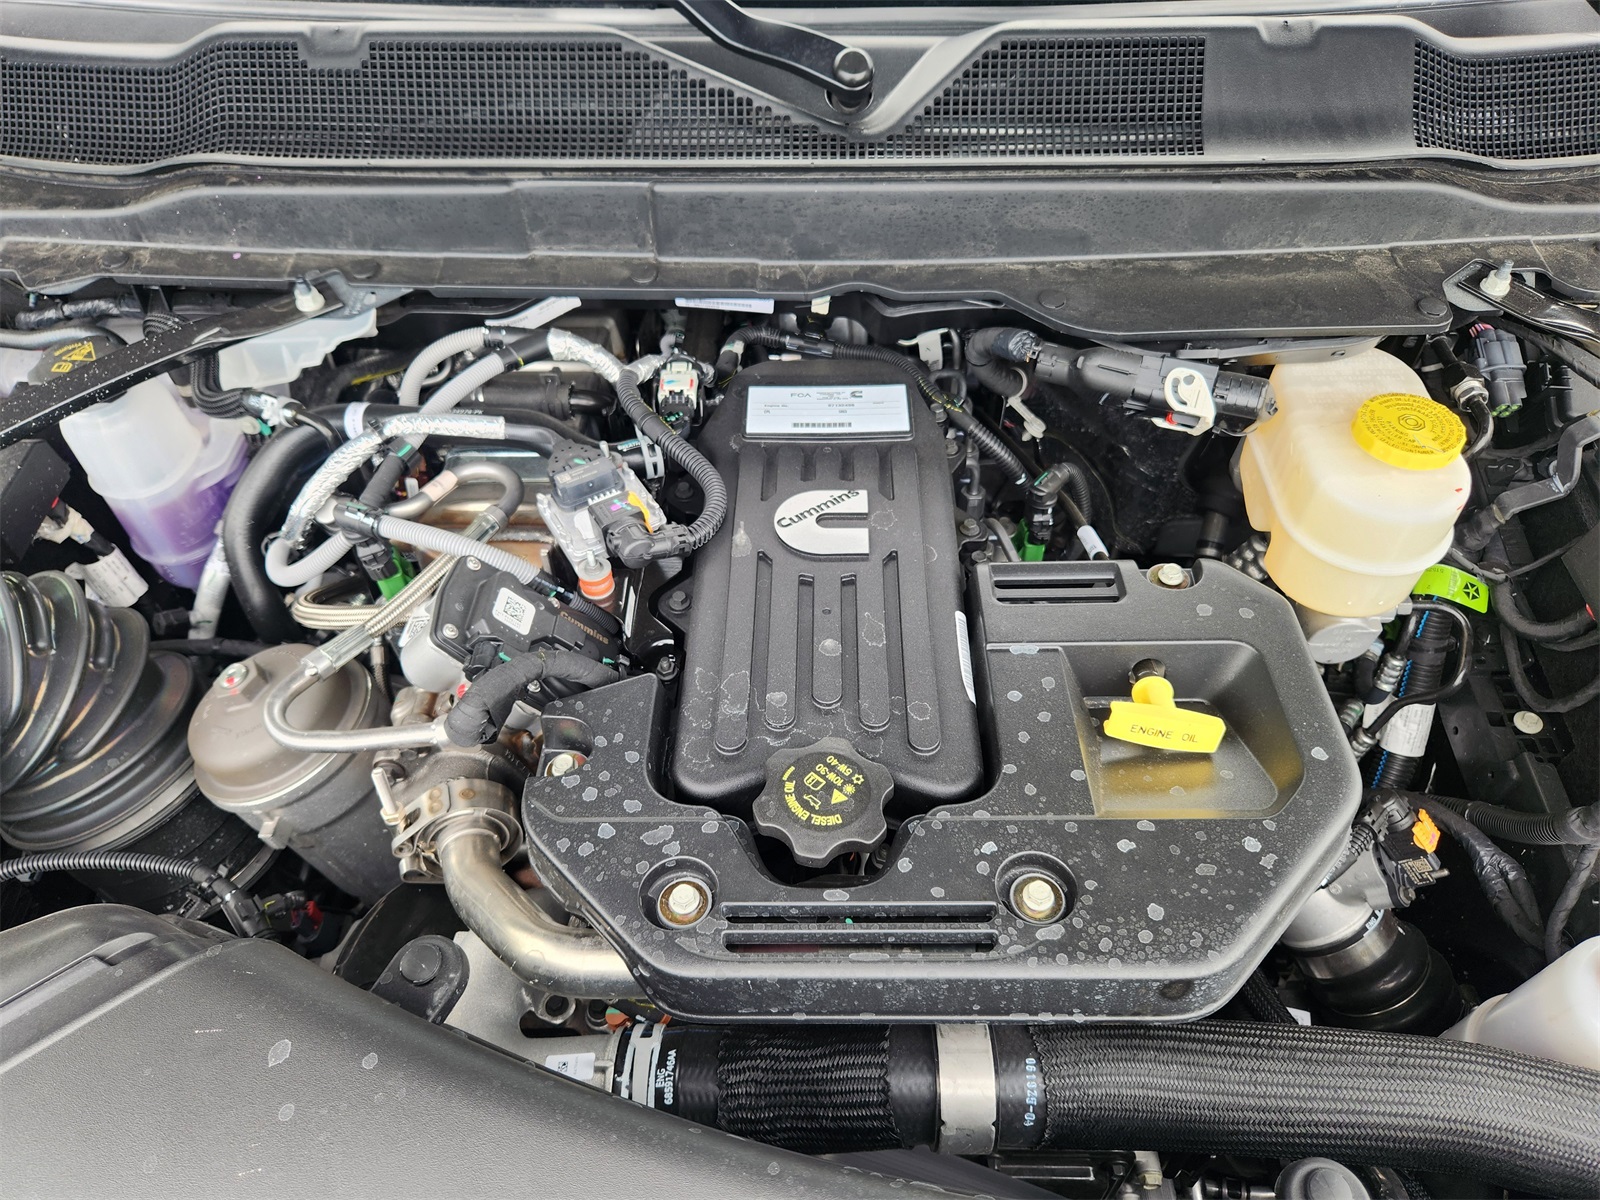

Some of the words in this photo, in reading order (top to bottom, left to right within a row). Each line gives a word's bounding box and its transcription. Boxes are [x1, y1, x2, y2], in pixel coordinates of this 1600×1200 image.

[776, 490, 859, 528] Cummins
[560, 611, 609, 645] Cummins
[1130, 724, 1173, 739] ENGINE
[1181, 732, 1198, 743] OIL
[816, 764, 844, 787] 10W-30
[826, 755, 853, 776] 5W-40
[784, 780, 796, 792] OIL
[784, 792, 810, 821] ENGINE
[811, 814, 843, 826] DIESEL
[655, 1068, 666, 1088] ENG
[664, 1048, 677, 1106] 68591746AA
